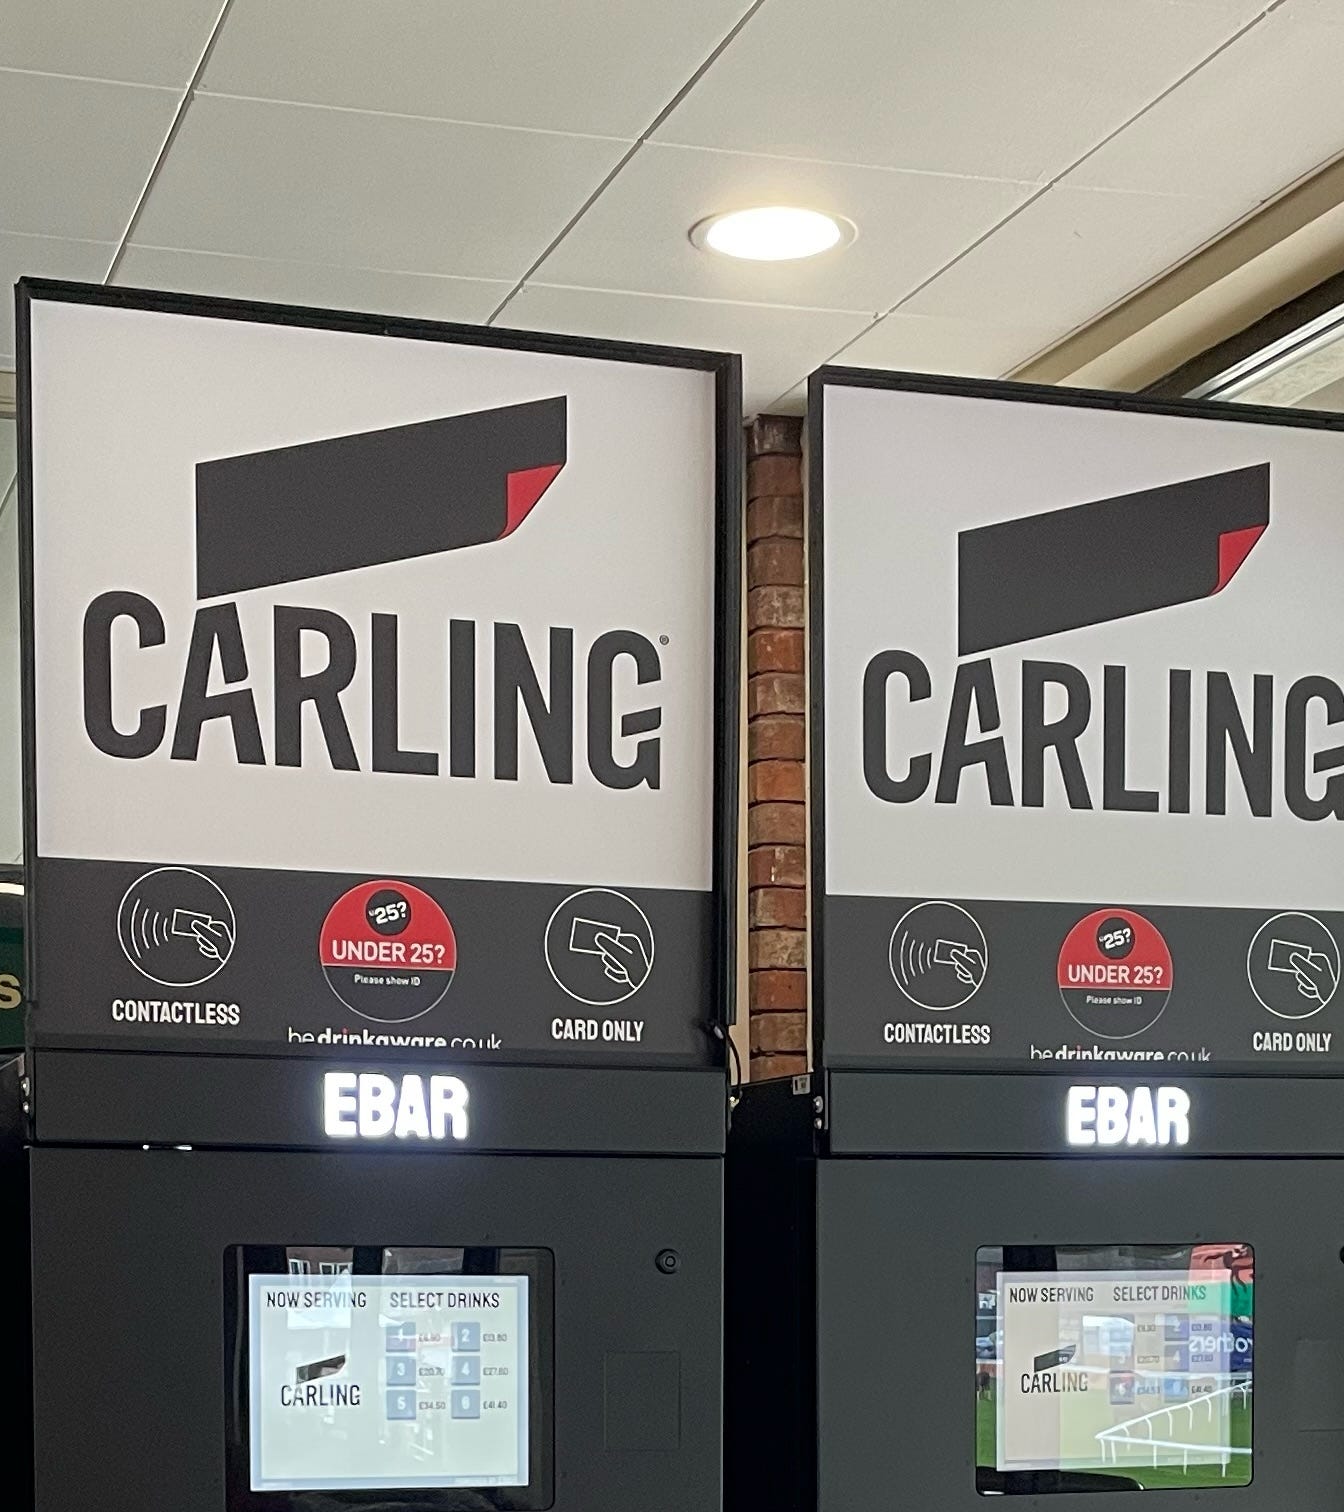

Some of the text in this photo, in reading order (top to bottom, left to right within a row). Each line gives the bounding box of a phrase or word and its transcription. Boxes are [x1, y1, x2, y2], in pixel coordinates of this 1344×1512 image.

[83, 591, 662, 790] CARLING
[332, 940, 446, 964] UNDER 25?
[354, 974, 421, 986] Please show ID
[1068, 964, 1163, 984] UNDER 25?
[1086, 995, 1142, 1005] Please show ID
[112, 999, 241, 1025] CONTACTLESS
[551, 1018, 644, 1042] CARD ONLY
[884, 1023, 991, 1045] CONTACTLESS
[1253, 1032, 1332, 1053] CARD ONLY
[323, 1072, 470, 1139] EBAR
[1066, 1085, 1191, 1147] EBAR
[266, 1292, 367, 1308] NOW SERVING
[389, 1292, 501, 1308] SELECT DRINKS
[1010, 1287, 1094, 1303] NOW SERVING
[1113, 1285, 1206, 1301] SELECT DRINKS
[461, 1328, 470, 1342] 2
[397, 1362, 406, 1376] 3
[461, 1362, 470, 1375] 4
[1021, 1372, 1088, 1394] CARLING
[281, 1384, 361, 1406] CARLING
